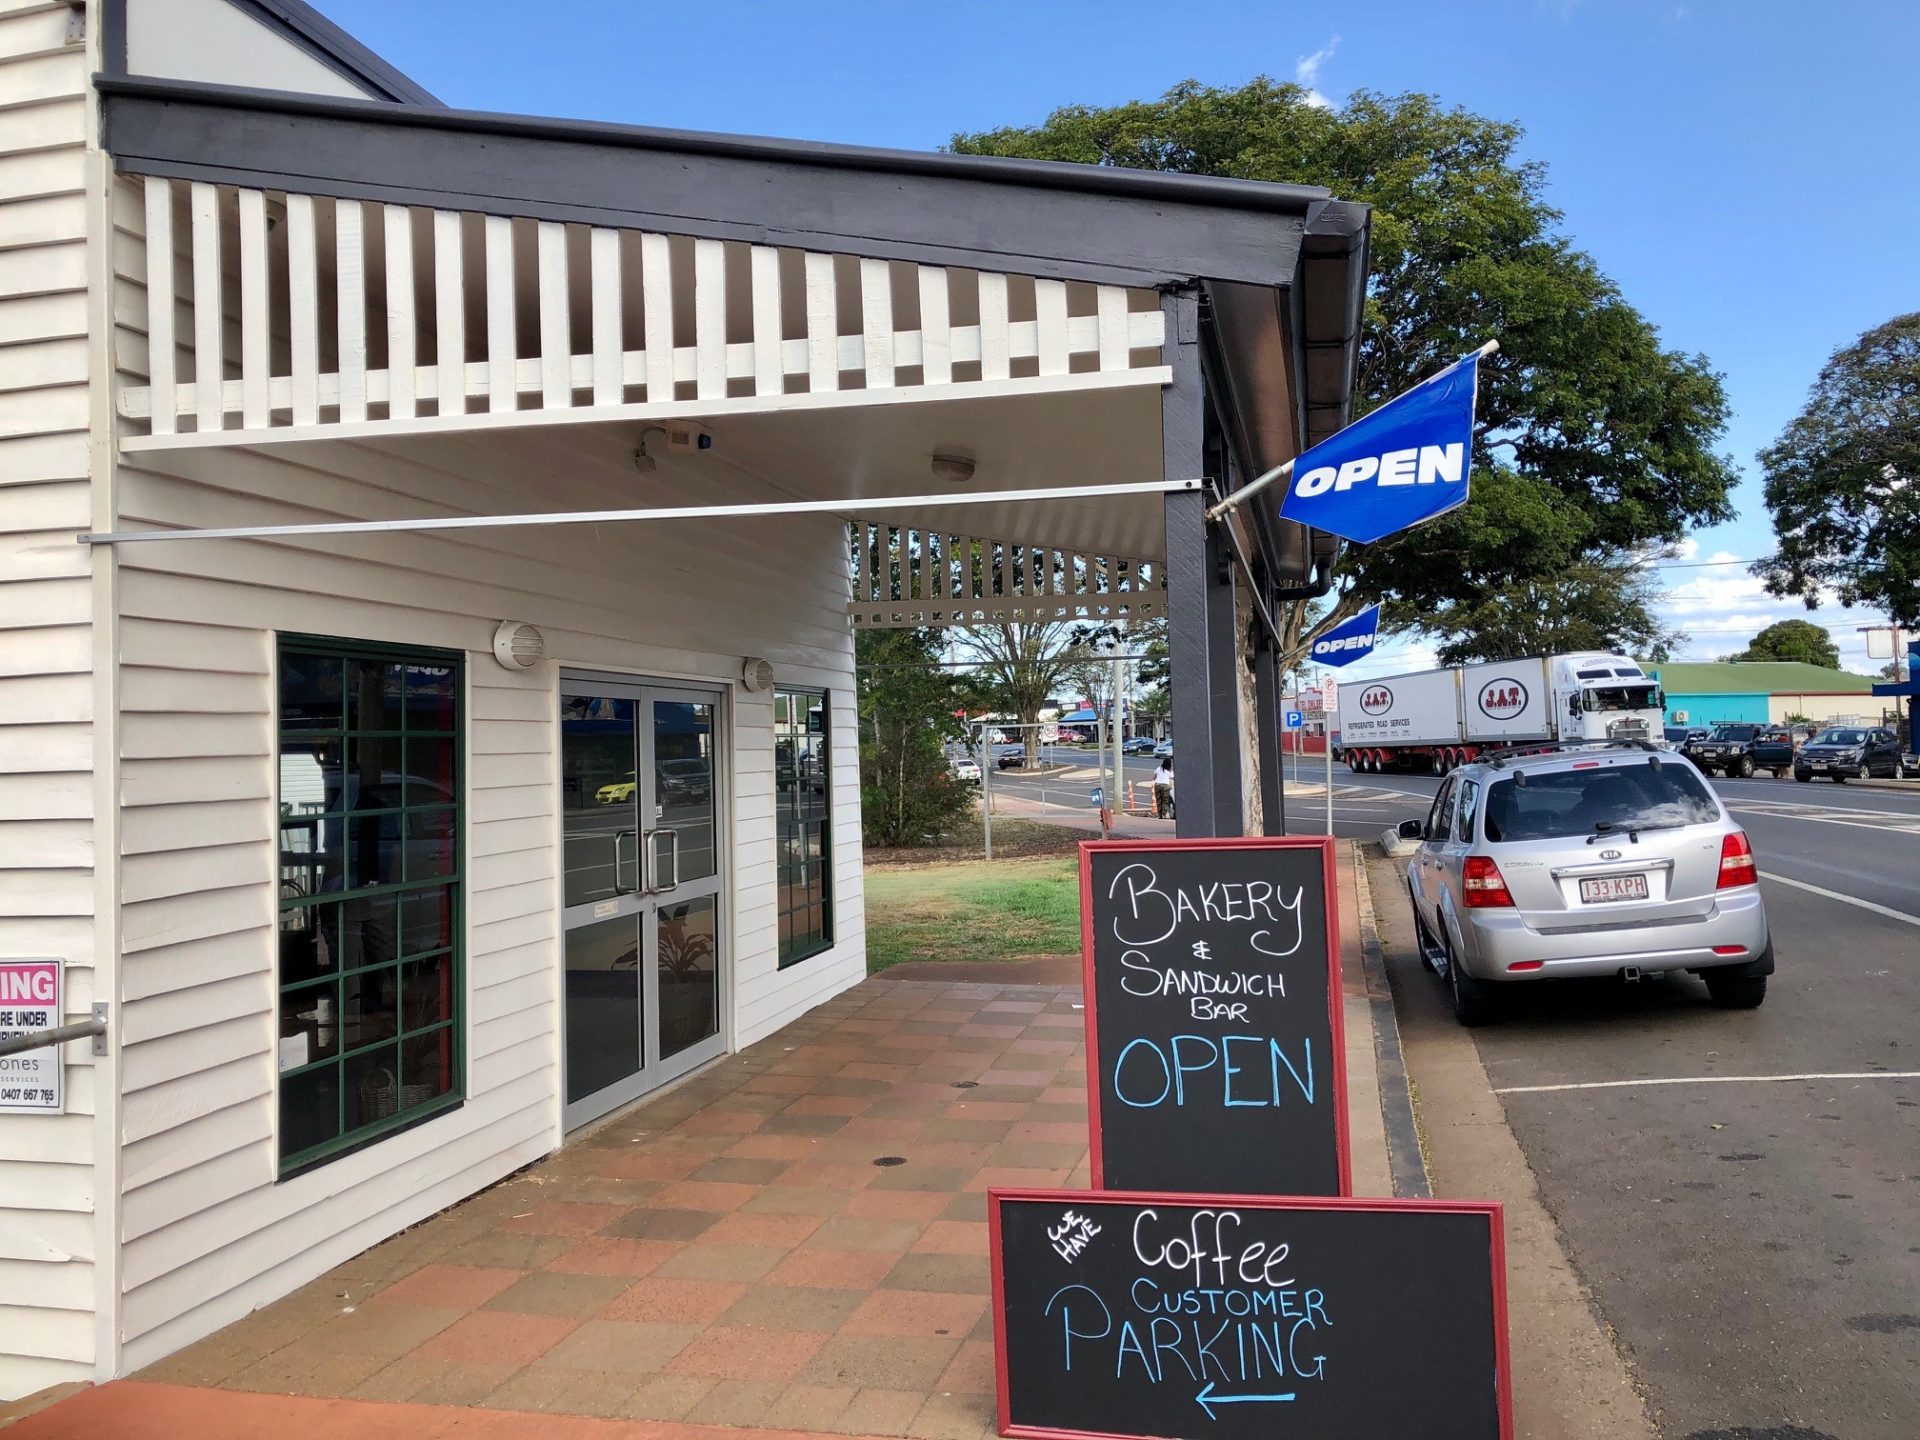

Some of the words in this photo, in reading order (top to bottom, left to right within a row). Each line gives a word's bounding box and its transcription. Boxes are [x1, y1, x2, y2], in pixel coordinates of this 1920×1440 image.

[1295, 442, 1464, 498] OPEN
[1315, 634, 1374, 655] OPEN
[1289, 713, 1299, 726] P
[1390, 718, 1410, 727] SERVICES
[1602, 851, 1620, 859] KIA
[1109, 863, 1304, 957] BAKERY
[1120, 950, 1286, 998] SANDWICH
[16, 1011, 47, 1027] UNDER
[1190, 996, 1250, 1024] BAR
[1113, 1034, 1315, 1108] OPEN
[1, 1088, 21, 1100] 0407
[23, 1088, 38, 1101] 667
[1047, 1210, 1084, 1242] WE
[1051, 1217, 1102, 1264] HAVE
[1133, 1210, 1296, 1288] Coffee
[1131, 1277, 1333, 1326] CUSTOMER
[1045, 1284, 1327, 1384] PARKING
